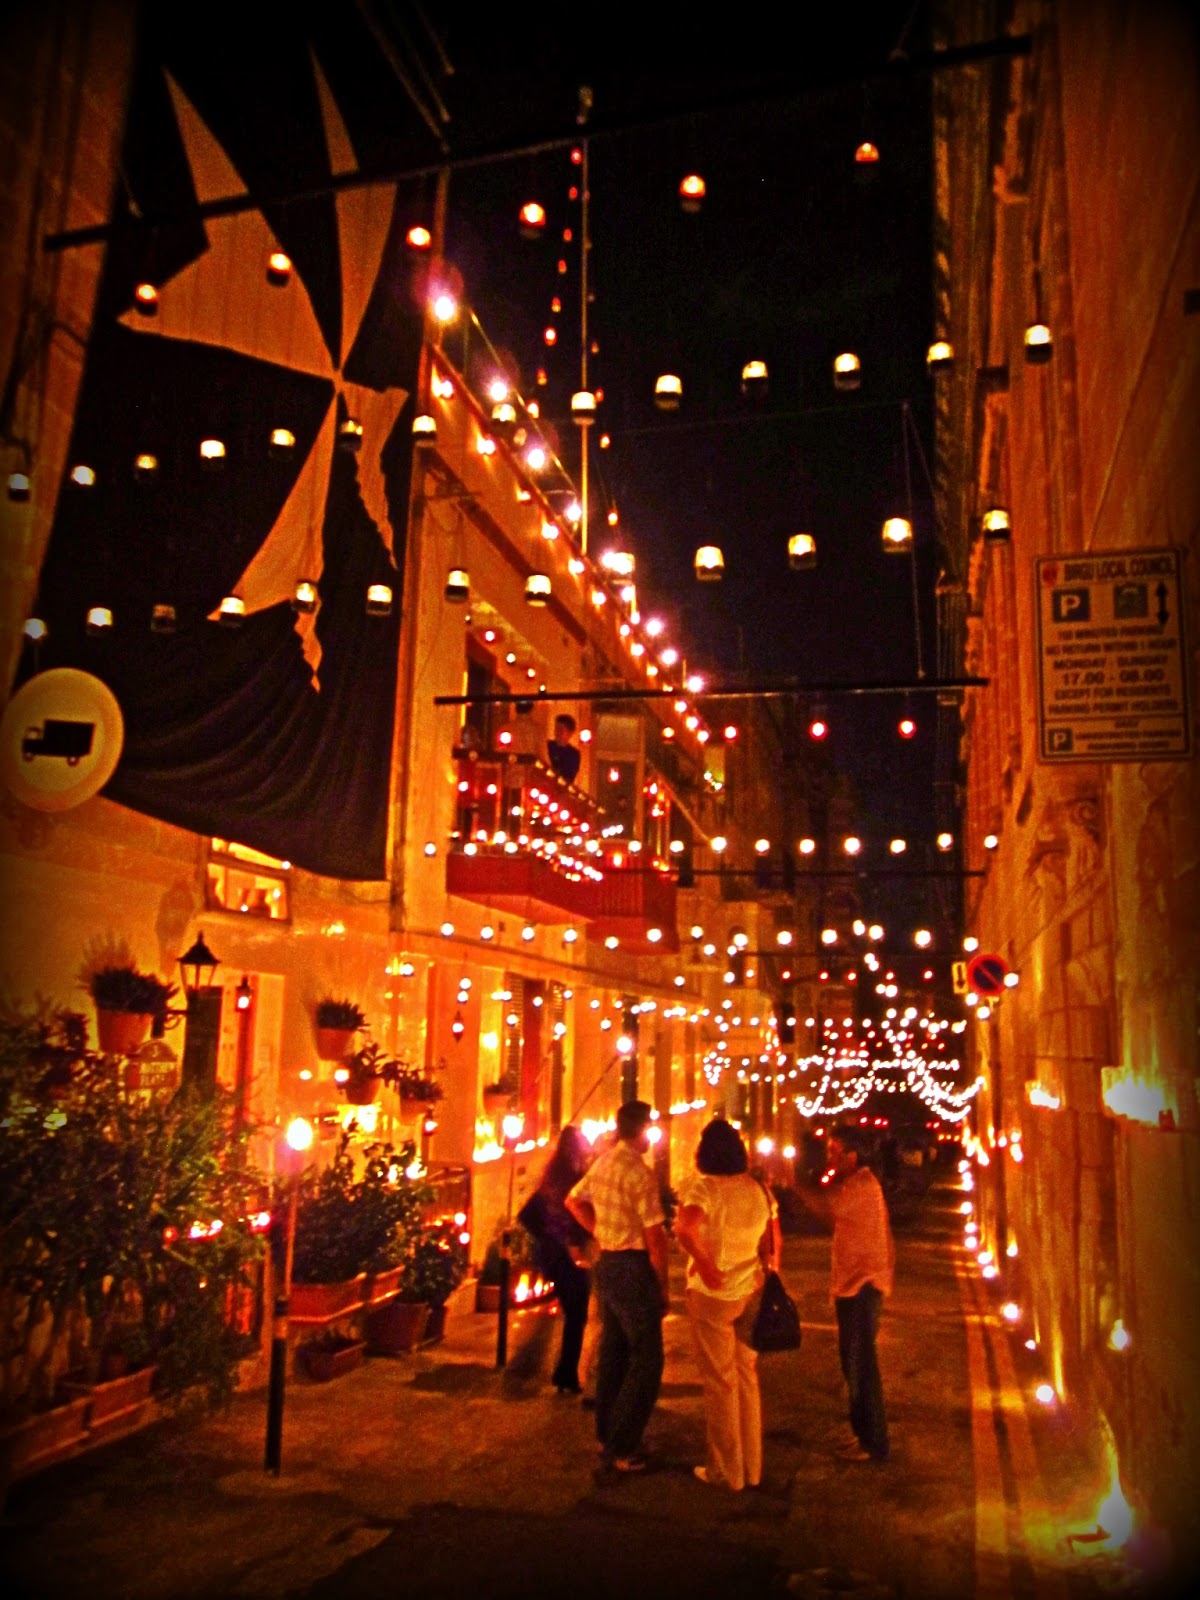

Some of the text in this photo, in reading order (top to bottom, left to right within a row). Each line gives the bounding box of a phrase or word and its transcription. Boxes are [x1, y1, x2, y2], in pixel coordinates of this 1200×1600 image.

[1097, 559, 1127, 580] LOCAL
[1130, 556, 1175, 577] COUNCIL
[1060, 595, 1081, 618] P
[1053, 657, 1106, 670] MONDAY
[1117, 654, 1168, 668] SUNDAY
[1062, 671, 1104, 686] 17.00
[1053, 732, 1067, 747] P
